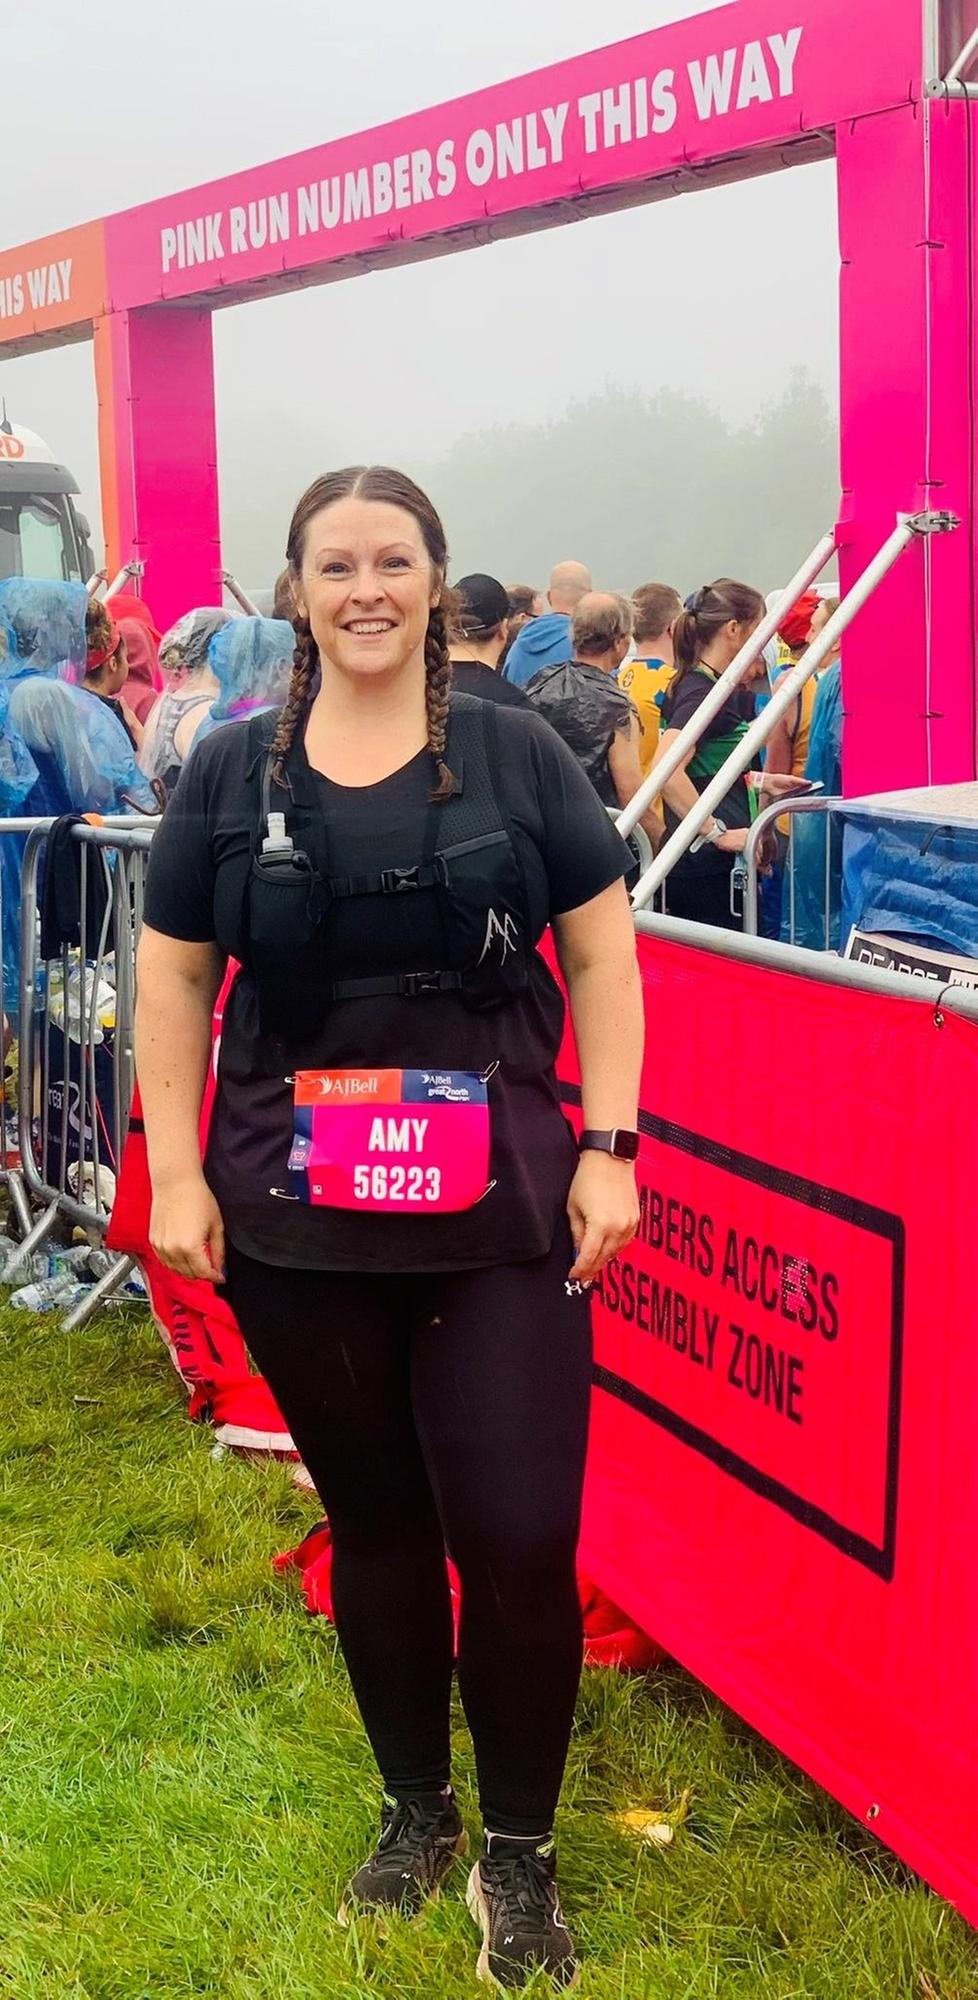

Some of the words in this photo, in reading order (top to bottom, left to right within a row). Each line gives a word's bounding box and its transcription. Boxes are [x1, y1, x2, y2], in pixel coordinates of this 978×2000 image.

[161, 212, 225, 273] PINK
[230, 192, 290, 254] RUN
[298, 140, 457, 236] NUMBERS
[465, 102, 569, 186] ONLY
[578, 69, 678, 153] THIS
[687, 26, 803, 121] WAY
[27, 259, 72, 309] WAY
[368, 1117, 429, 1153] AMY
[354, 1165, 441, 1201] 56223
[721, 1228, 839, 1341] ACCESS
[728, 1322, 804, 1426] ZONE
